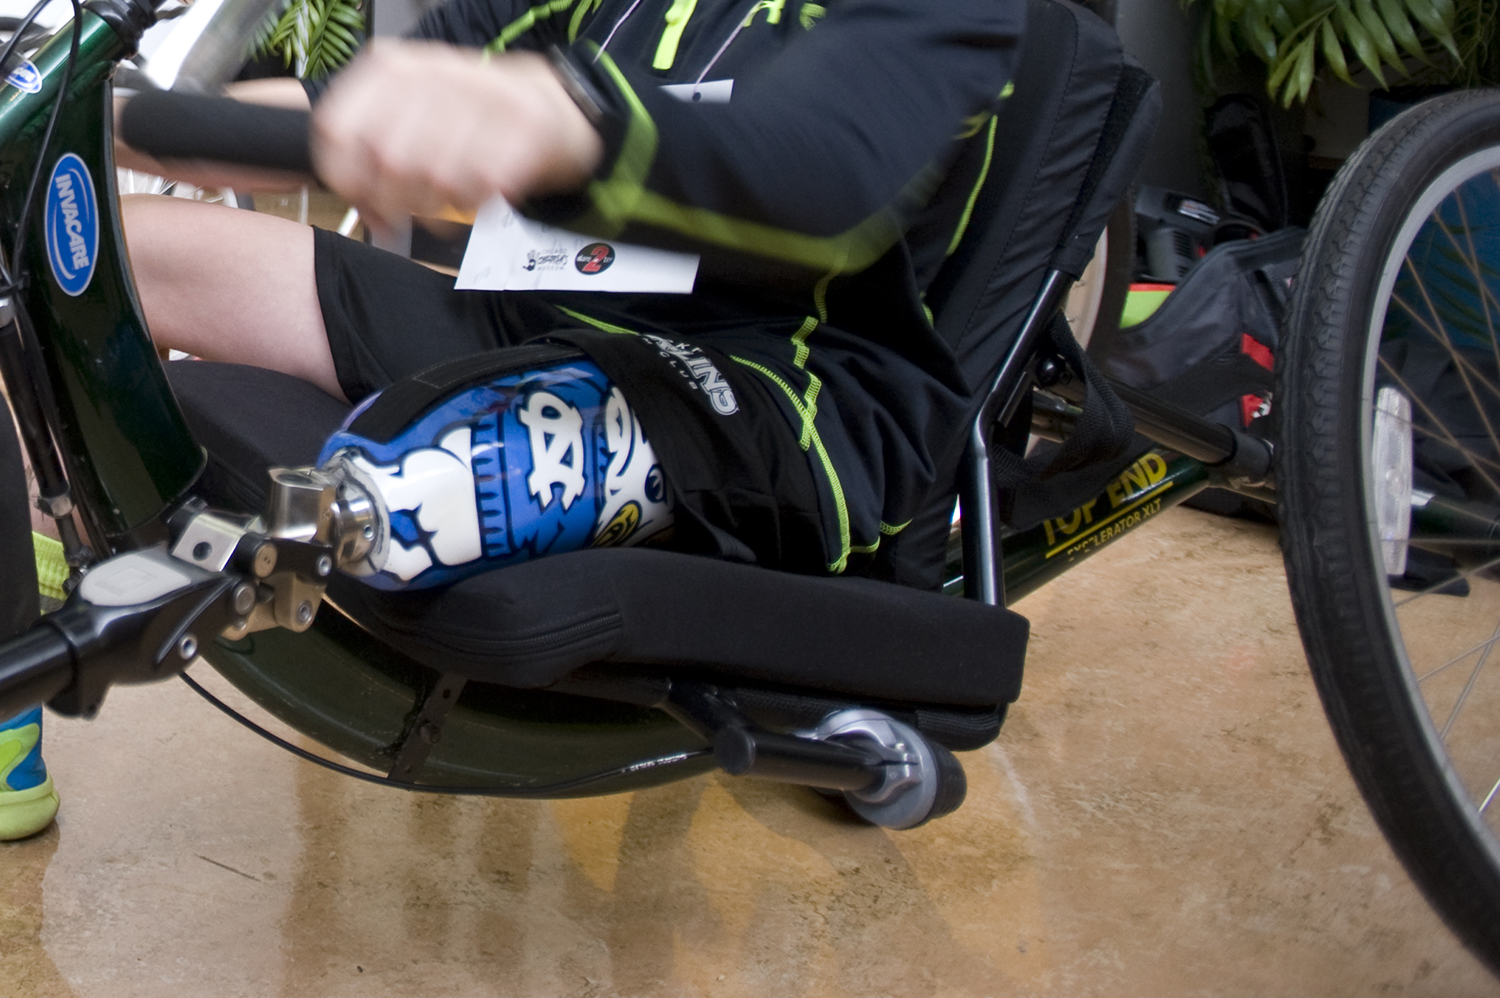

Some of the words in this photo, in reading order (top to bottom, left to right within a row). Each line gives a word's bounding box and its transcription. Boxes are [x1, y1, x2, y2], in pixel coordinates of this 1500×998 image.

[55, 173, 91, 271] INVACARE
[1105, 452, 1168, 509] END
[1141, 498, 1162, 520] XLT
